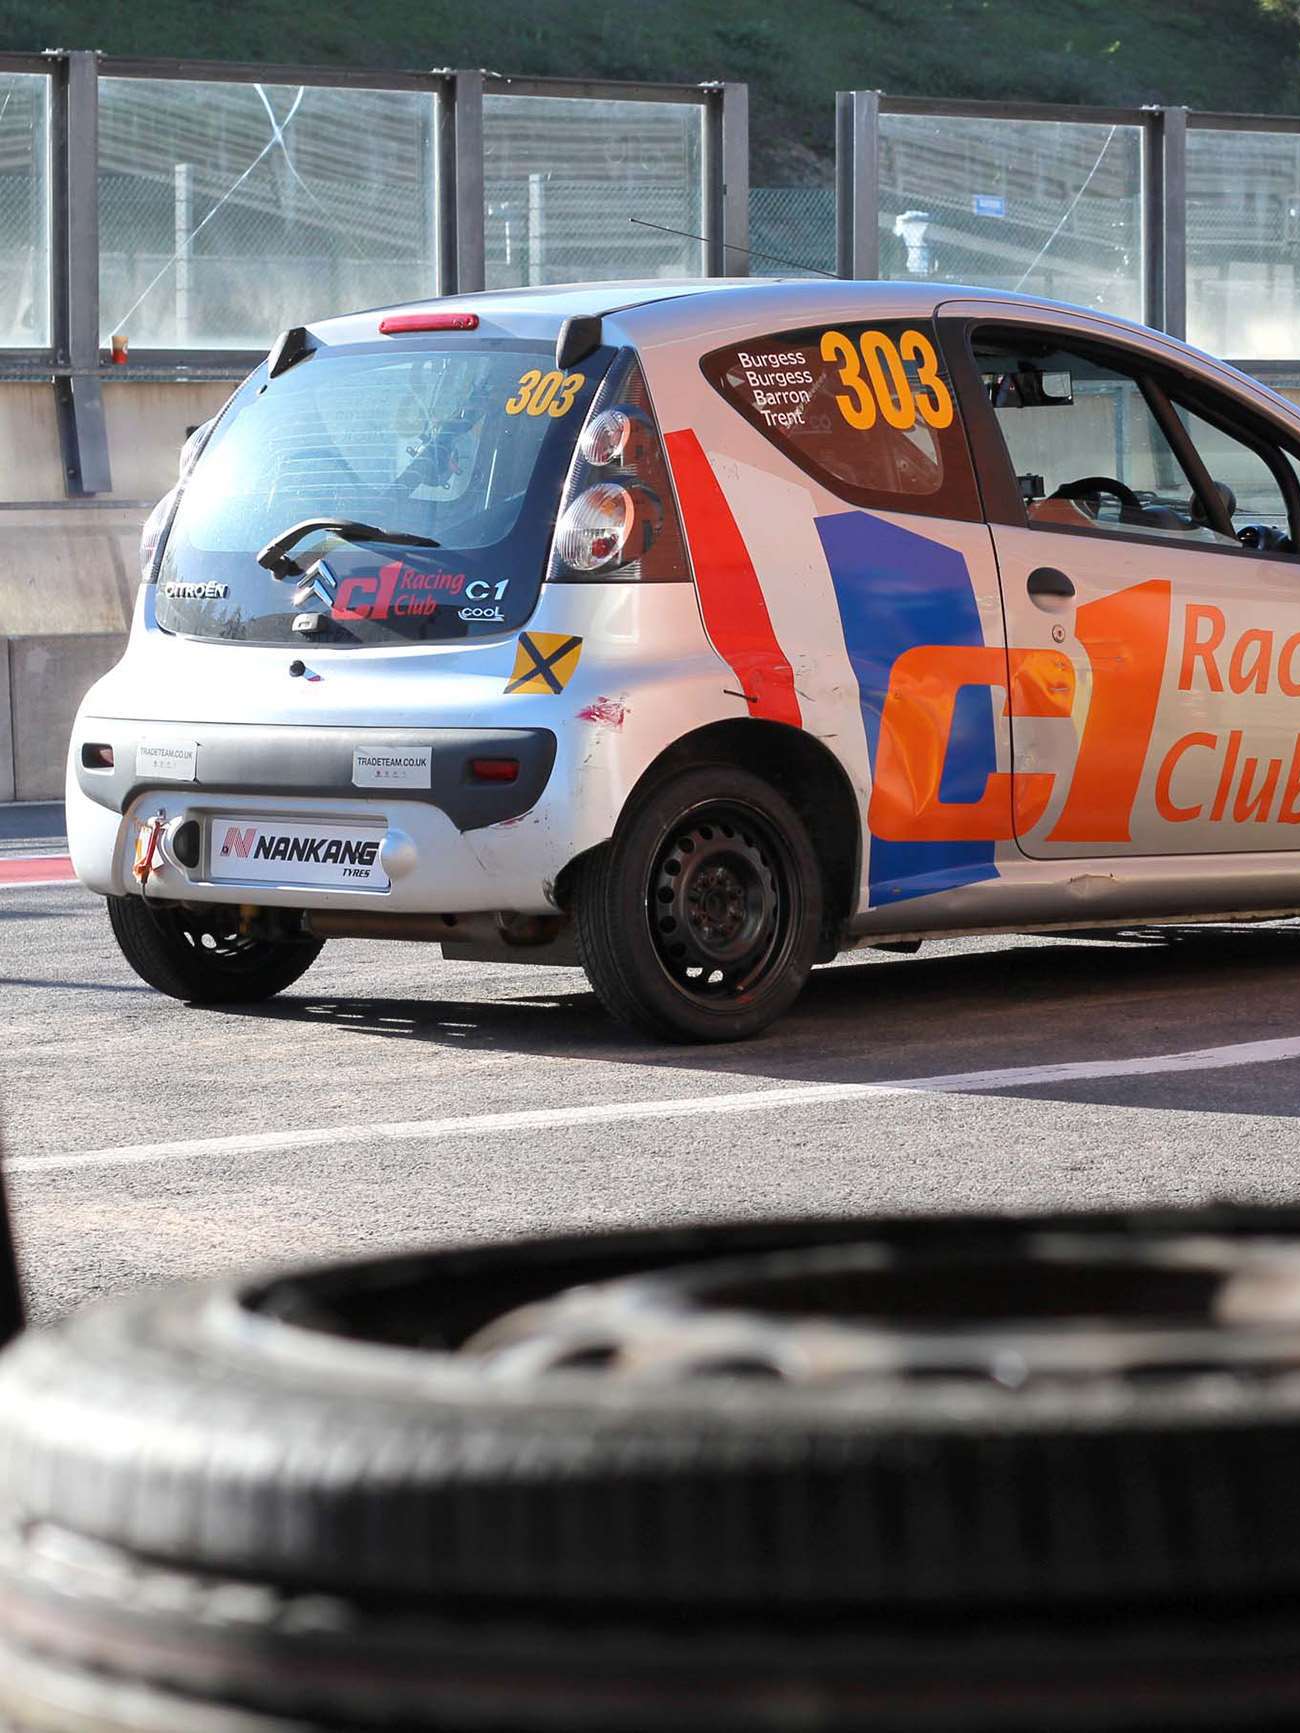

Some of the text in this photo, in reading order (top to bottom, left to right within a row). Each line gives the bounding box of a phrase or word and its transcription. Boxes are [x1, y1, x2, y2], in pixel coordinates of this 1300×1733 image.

[738, 351, 806, 369] Burgess
[746, 370, 813, 388] Burgess
[819, 329, 954, 430] 303
[505, 369, 585, 418] 303
[753, 389, 811, 407] Barron
[761, 407, 806, 428] Trent
[401, 568, 466, 596] Racing
[465, 578, 509, 601] C1
[394, 595, 438, 617] Club
[140, 747, 193, 760] TRADETEAM.CO.UK
[357, 757, 428, 767] TRADETEAM.CO.UK
[253, 835, 381, 867] NANKANG
[342, 868, 371, 878] TYRES
